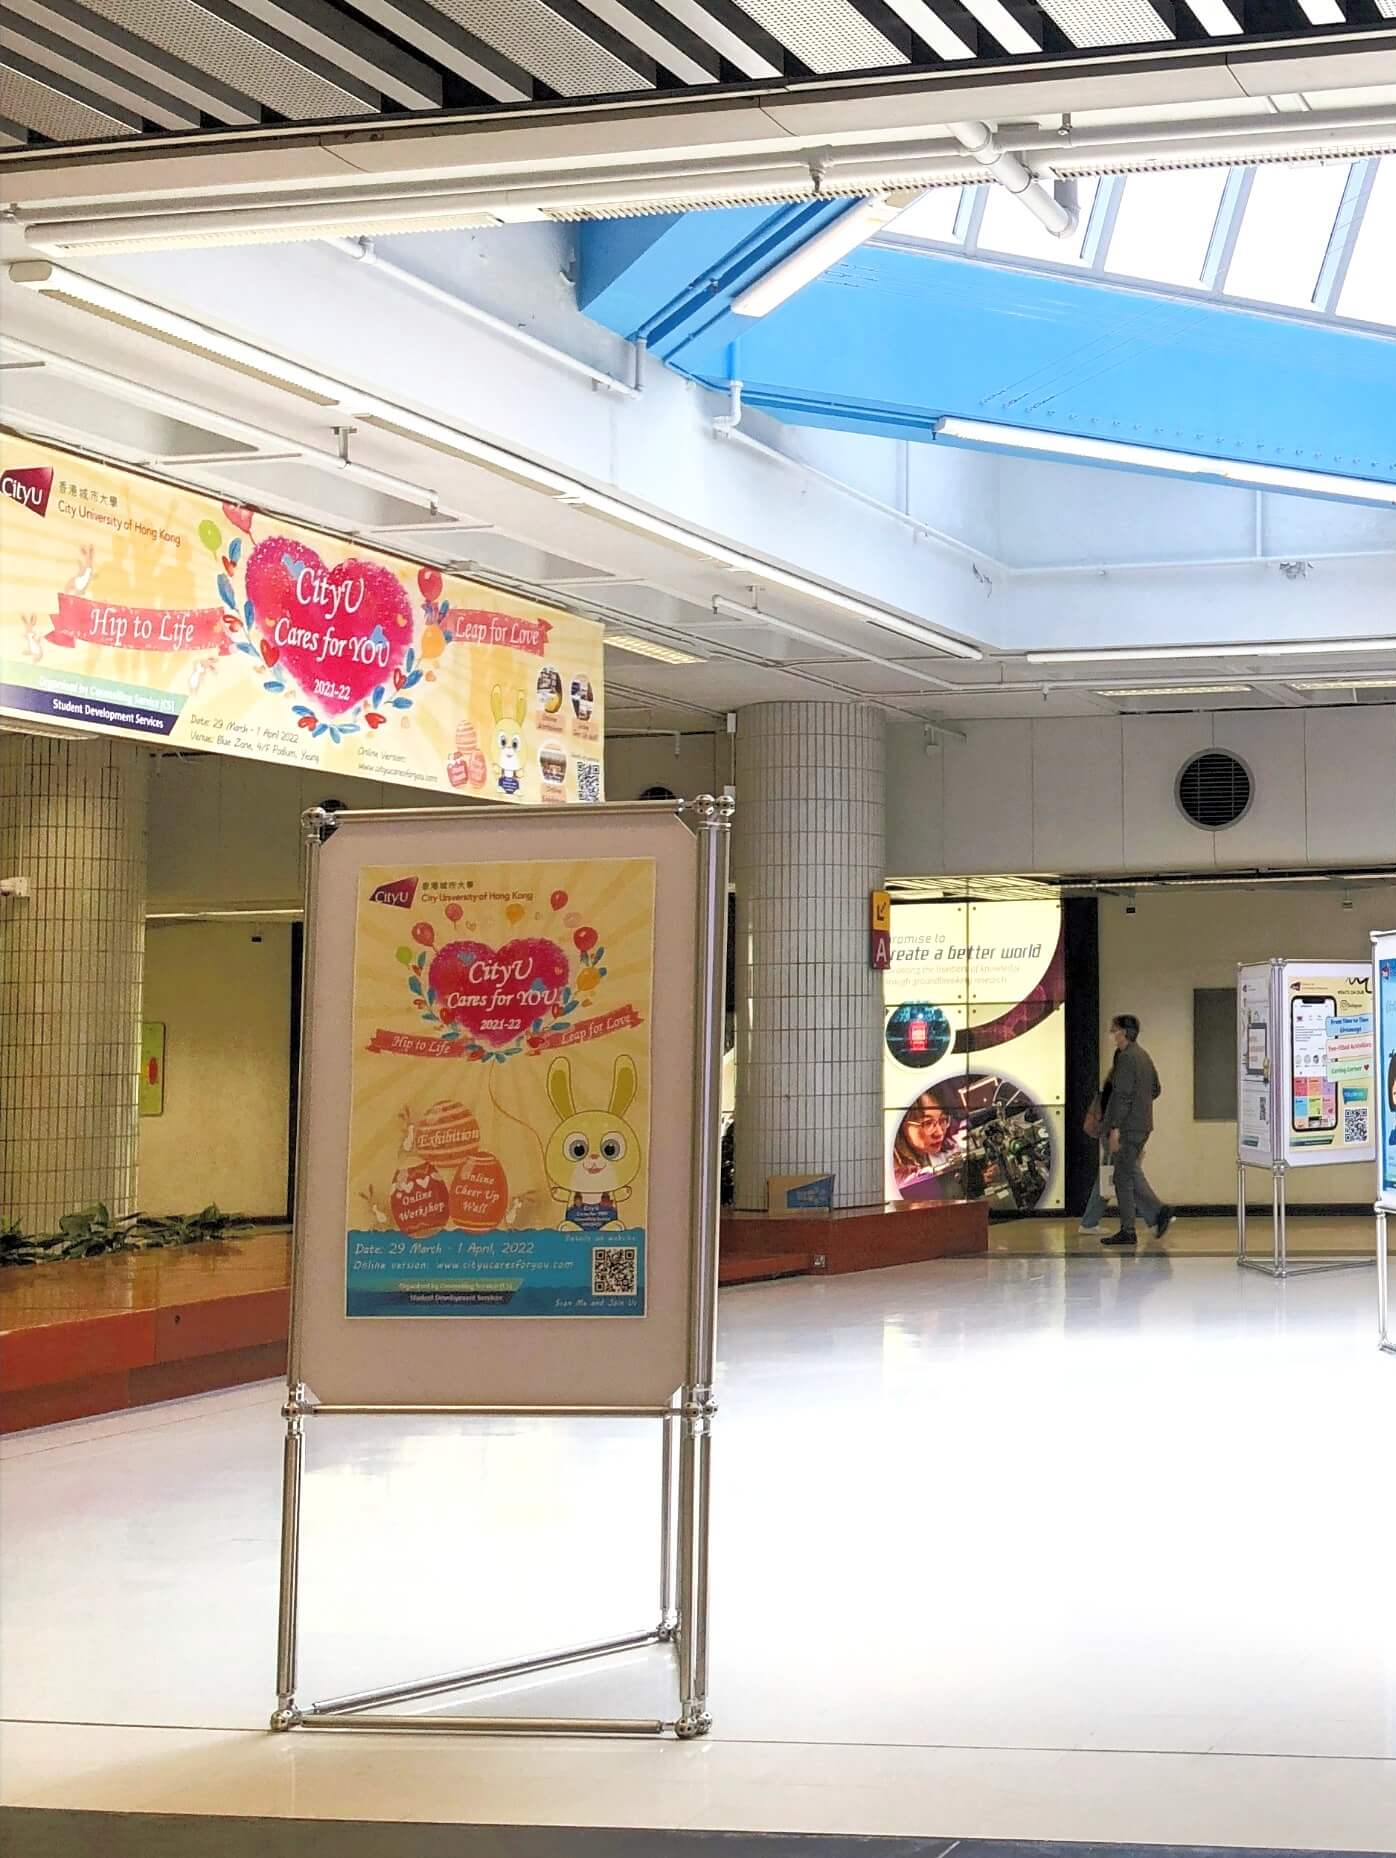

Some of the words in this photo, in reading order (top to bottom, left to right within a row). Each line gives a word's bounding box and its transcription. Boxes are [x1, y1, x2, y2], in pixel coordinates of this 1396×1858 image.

[0, 477, 44, 505] CityU
[58, 500, 76, 518] City
[78, 506, 122, 530] University
[124, 519, 133, 530] of
[135, 523, 158, 541] Hong
[159, 529, 181, 547] Kong
[296, 567, 365, 620] CityU
[90, 608, 128, 647] Hip
[133, 618, 152, 639] to
[158, 614, 194, 649] Life
[455, 616, 487, 645] Leap
[490, 618, 507, 646] for
[510, 624, 540, 645] Love
[274, 618, 319, 651] Cares
[316, 627, 346, 662] for
[350, 637, 390, 667] YOU
[313, 679, 350, 701] 2021-22
[53, 699, 83, 715] Student
[84, 704, 134, 724] Development
[135, 715, 164, 729] Services
[374, 890, 409, 904] CityU
[421, 894, 438, 904] City
[440, 892, 478, 903] University
[489, 891, 510, 902] Hong
[511, 890, 534, 902] Kong
[935, 934, 946, 944] to
[876, 938, 887, 963] A
[889, 946, 930, 961] reate
[934, 949, 943, 961] a
[947, 945, 996, 960] better
[1001, 943, 1042, 960] world
[469, 957, 534, 988] CityU
[447, 991, 487, 1010] Cares
[487, 988, 515, 1012] for
[516, 990, 557, 1006] YOU
[480, 1018, 522, 1031] 2021-22
[561, 1029, 588, 1046] Leap
[588, 1021, 603, 1037] for
[607, 1013, 632, 1031] Love
[416, 1039, 427, 1051] to
[428, 1040, 451, 1055] Life
[418, 1128, 480, 1147] Exhibition
[402, 1190, 433, 1206] Online
[455, 1184, 482, 1199] Cheer
[485, 1190, 500, 1204] Up
[399, 1201, 445, 1221] Workshop
[462, 1200, 488, 1214] Wall
[355, 1243, 384, 1255] Date:
[389, 1243, 406, 1254] 29
[409, 1242, 442, 1254] March
[467, 1242, 496, 1257] April,
[502, 1242, 534, 1255] 2022
[353, 1260, 386, 1270] Online
